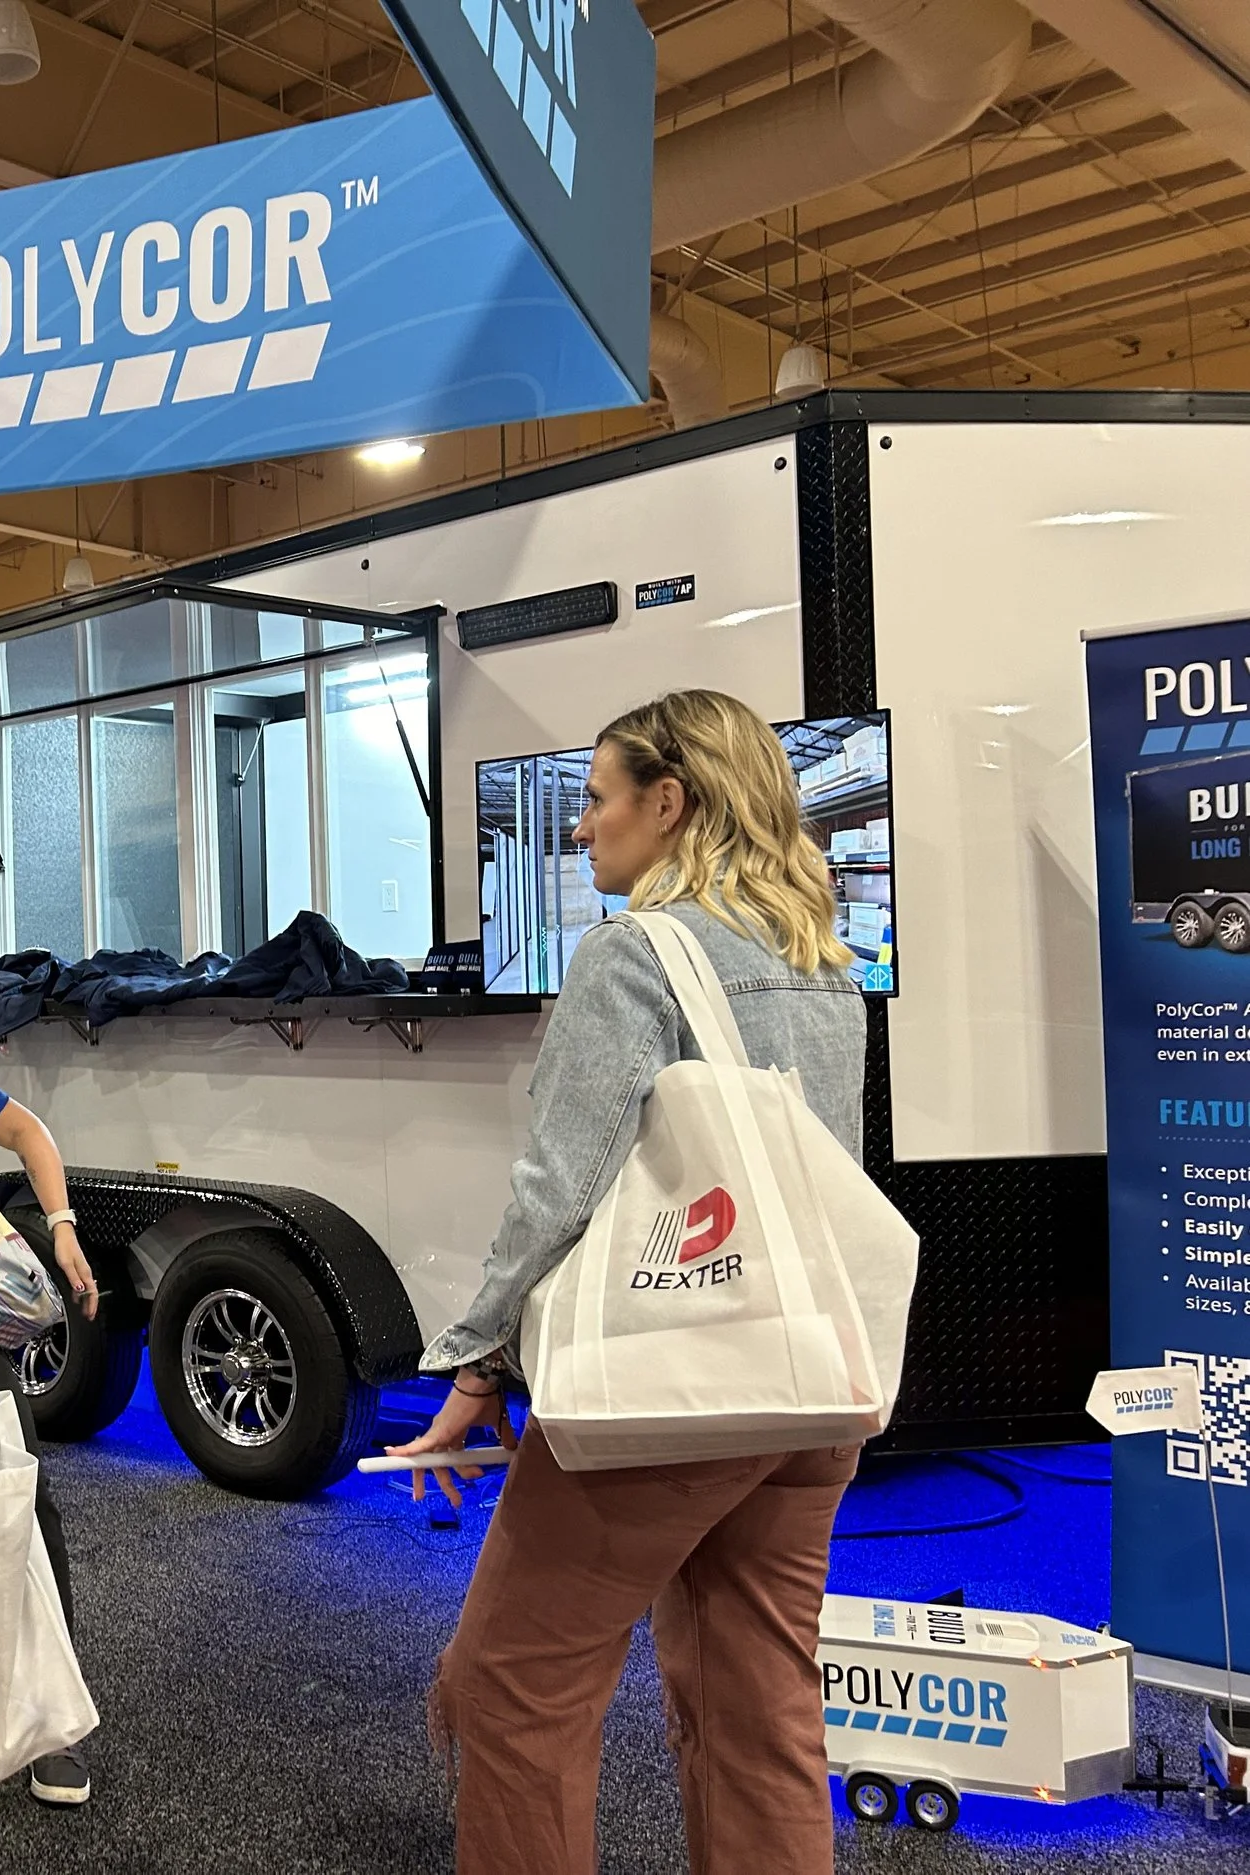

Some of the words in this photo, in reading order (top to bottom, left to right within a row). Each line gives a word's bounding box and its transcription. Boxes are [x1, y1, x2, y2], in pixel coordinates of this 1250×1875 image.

[1144, 656, 1250, 721] POL
[1223, 823, 1246, 832] FOR
[1191, 837, 1242, 860] LONG
[1156, 1024, 1229, 1040] material
[1157, 1049, 1198, 1062] even
[1202, 1047, 1220, 1062] in
[1159, 1098, 1250, 1128] FEATU
[1184, 1218, 1245, 1241] Easily
[630, 1253, 743, 1290] DEXTER
[1184, 1295, 1237, 1316] sizes,
[926, 1609, 966, 1645] BUILD
[822, 1662, 1008, 1723] POLYCOR
